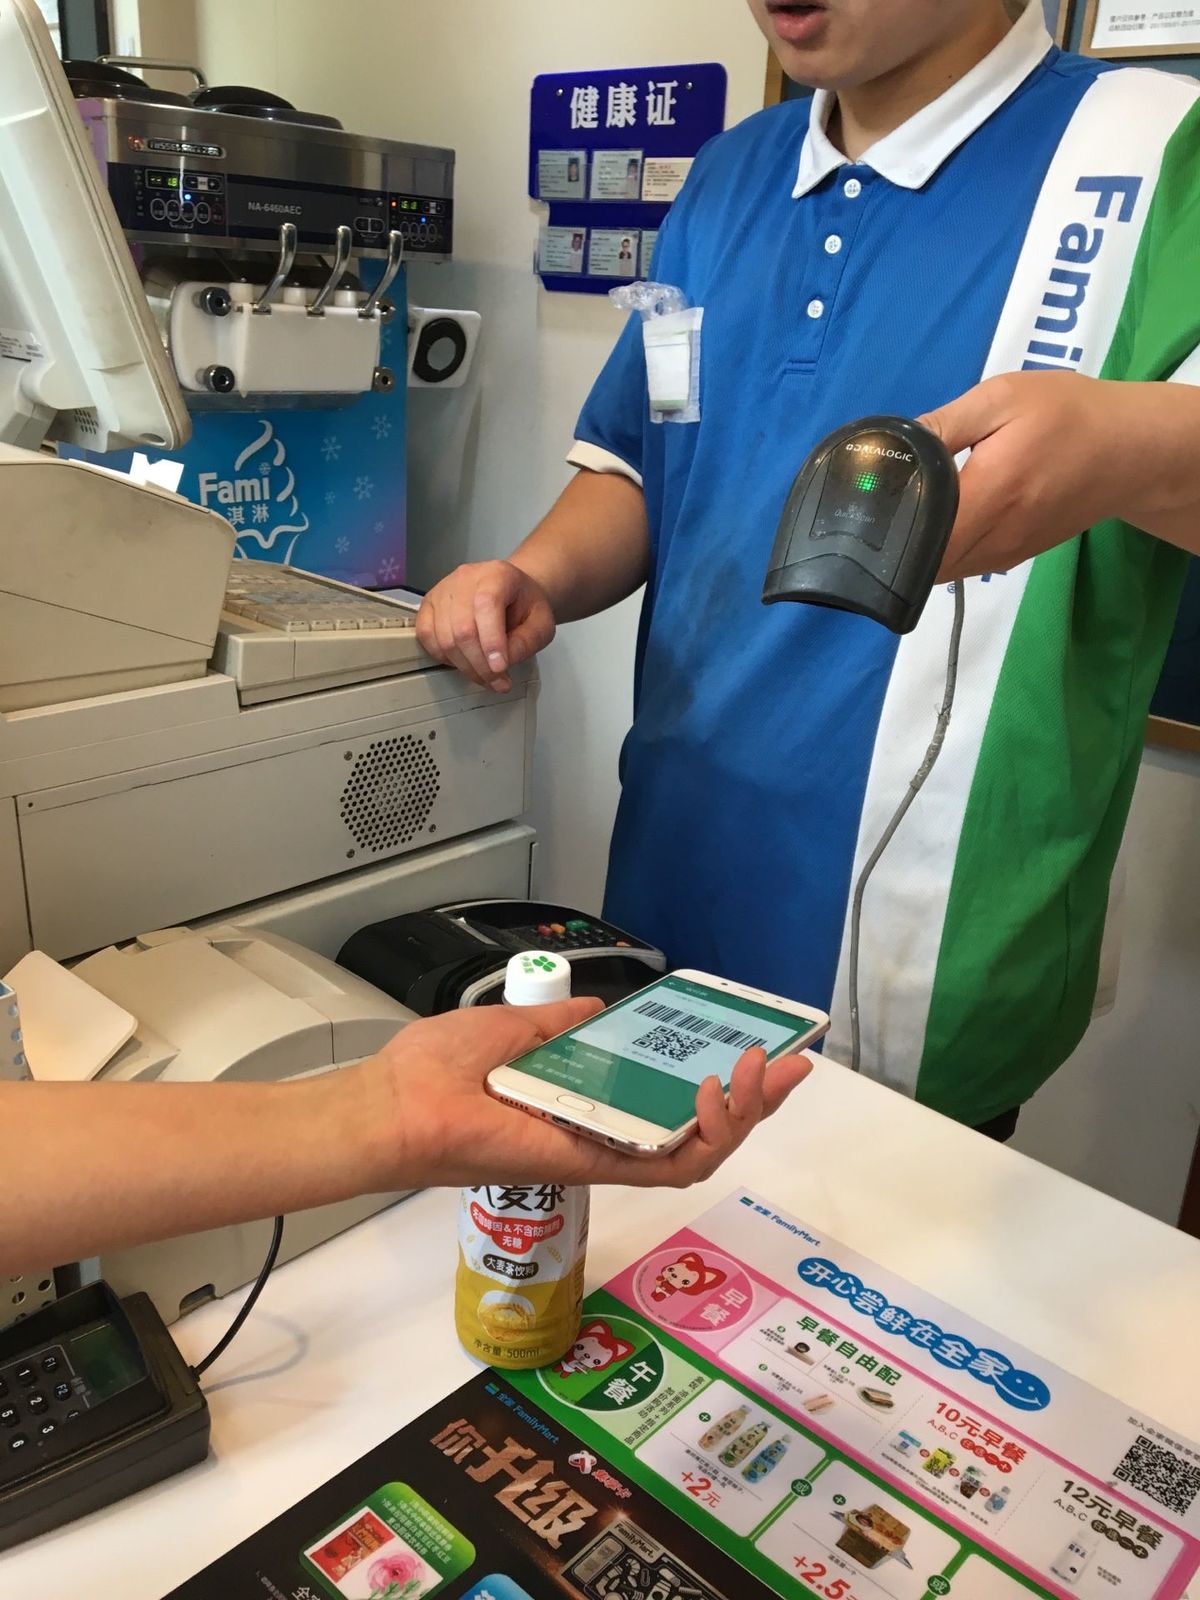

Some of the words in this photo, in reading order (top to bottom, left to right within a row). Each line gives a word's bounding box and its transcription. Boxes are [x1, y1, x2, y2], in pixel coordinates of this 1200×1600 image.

[569, 80, 679, 129] 健康证
[847, 443, 913, 462] DATALOGIC
[199, 464, 271, 505] Fami
[771, 1214, 821, 1247] FamilyMart
[486, 1257, 536, 1277] 大麦茶饮料
[699, 1288, 748, 1327] 早餐
[802, 1261, 1011, 1378] 开心尝鲜在全家
[797, 1315, 903, 1387] 早餐自由配
[30, 1397, 43, 1406] 2
[603, 1360, 658, 1405] 午餐
[1, 1409, 14, 1419] 5
[42, 1425, 55, 1434] 3
[513, 1404, 560, 1445] FamilyMart
[935, 1402, 1028, 1465] 10元早餐
[430, 1418, 598, 1550] 你升级
[681, 1471, 721, 1508] +2元
[1062, 1480, 1165, 1551] 12元早餐
